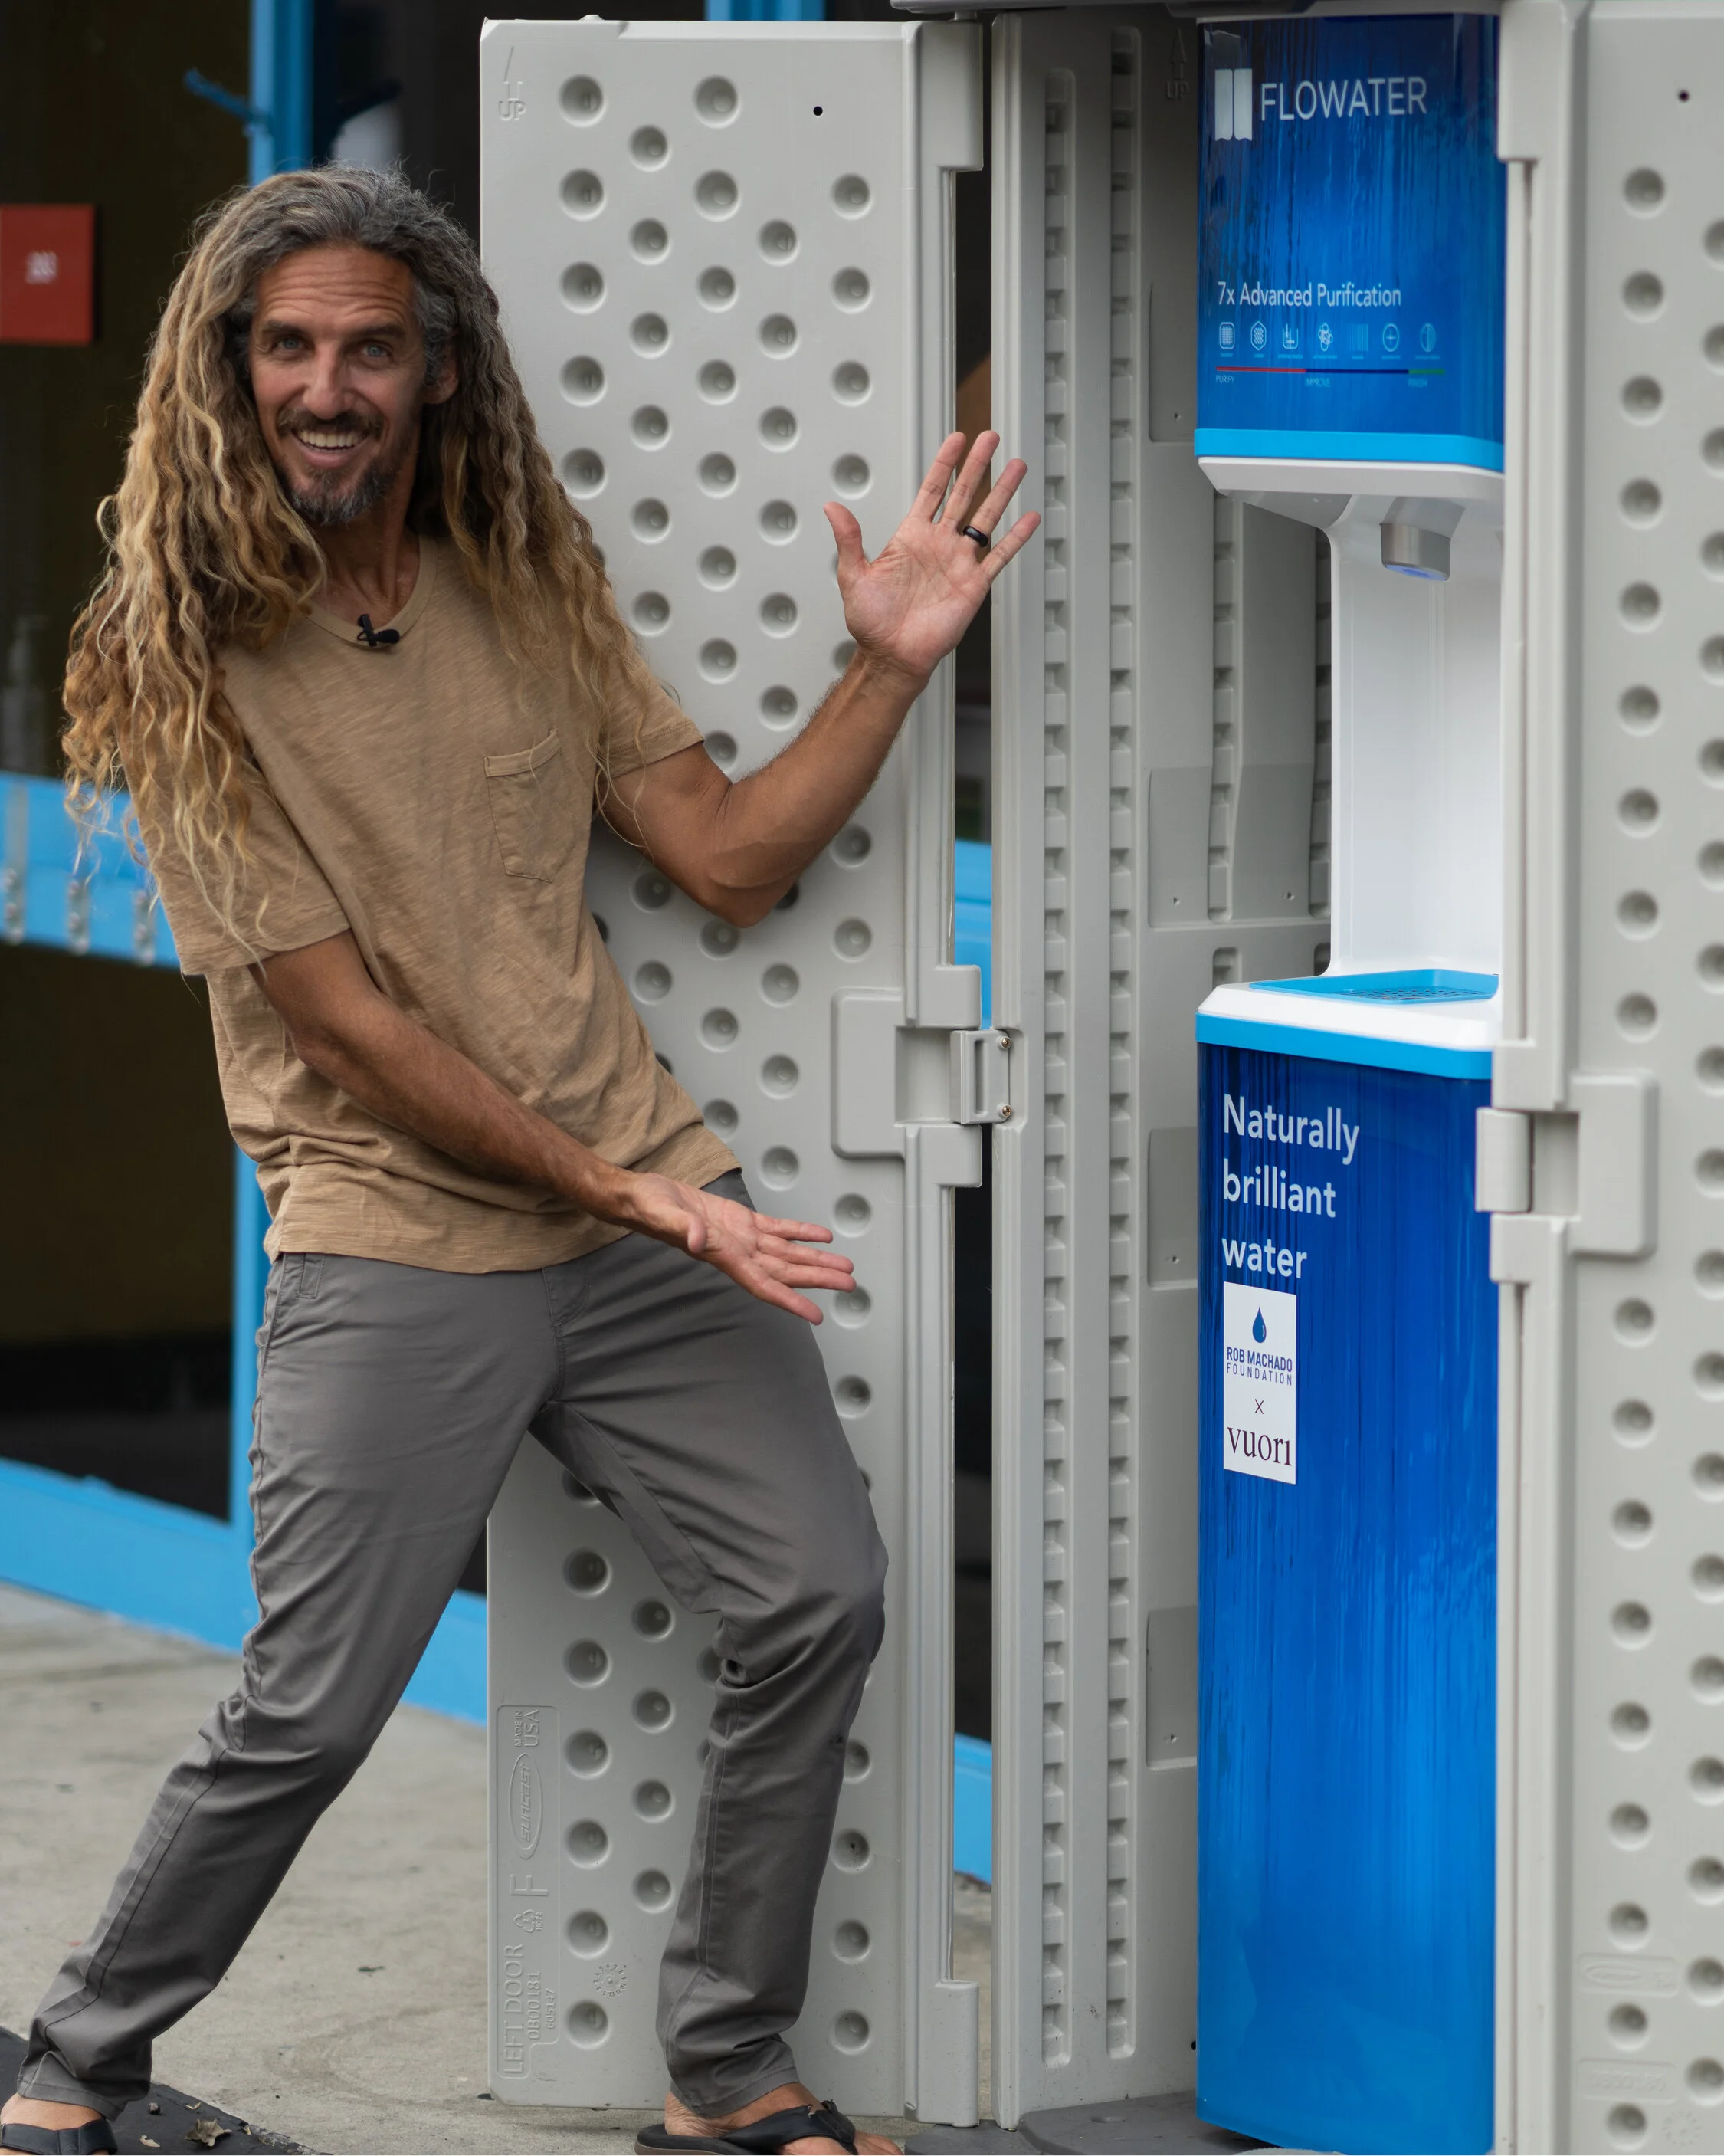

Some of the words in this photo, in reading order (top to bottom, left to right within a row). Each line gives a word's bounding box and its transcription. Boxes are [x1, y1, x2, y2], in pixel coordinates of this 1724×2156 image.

[1165, 80, 1190, 101] UP
[1261, 77, 1428, 121] FLOWATER
[499, 100, 527, 121] UP
[1217, 281, 1236, 305] 7x
[1239, 282, 1312, 307] Advanced
[1317, 281, 1401, 307] Purification
[1215, 374, 1235, 384] PURIFY
[1305, 377, 1331, 388] IMPROVE
[1223, 1093, 1360, 1166] Naturally
[1223, 1158, 1336, 1219] brilliant
[1221, 1237, 1308, 1279] water
[1227, 1346, 1245, 1363] ROB
[1247, 1350, 1293, 1373] MACHADO
[1227, 1362, 1293, 1386] FOUNDATION
[514, 1709, 523, 1719] IN
[514, 1721, 523, 1747] MADE
[523, 1709, 539, 1747] USA
[503, 1943, 524, 2013] DOOR
[503, 2020, 524, 2074] LEFT
